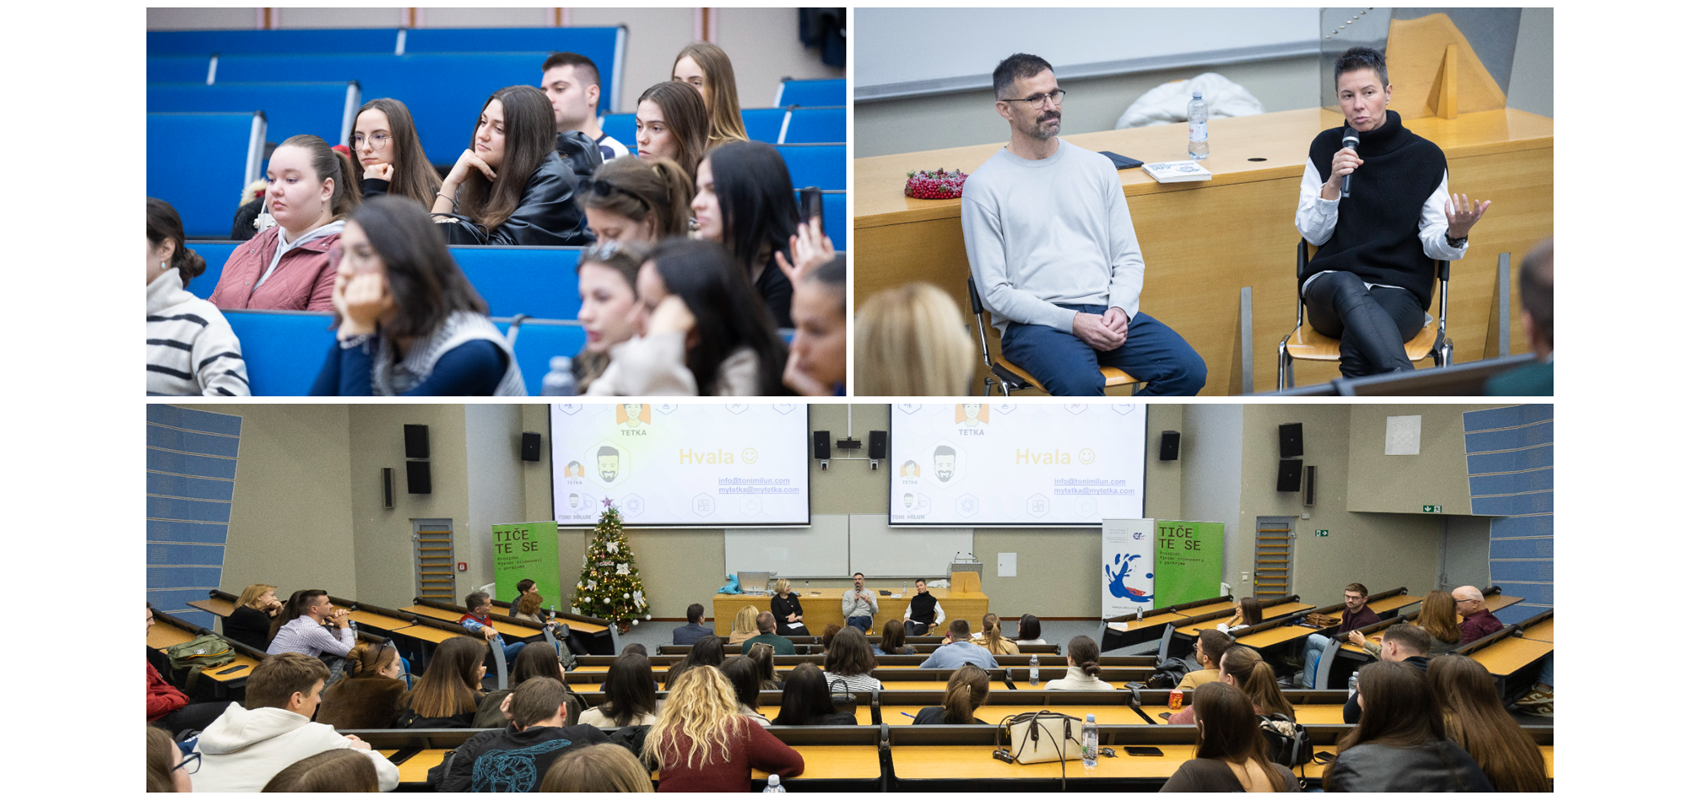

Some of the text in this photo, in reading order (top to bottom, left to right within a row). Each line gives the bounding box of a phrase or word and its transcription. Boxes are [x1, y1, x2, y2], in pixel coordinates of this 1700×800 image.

[620, 429, 647, 437] TETKA
[958, 428, 985, 436] TETKA
[679, 448, 735, 465] Hvala
[1016, 448, 1072, 465] Hvala
[718, 477, 790, 486] info@tonimilun.com
[1053, 478, 1126, 487] info@tonimilun.com
[718, 486, 800, 495] mytetka@mytetka.com
[1053, 487, 1136, 496] mytetka@mytetka.com
[494, 527, 529, 542] TIČE
[1159, 525, 1193, 539] TIČE
[495, 541, 538, 554] TE SE
[1159, 538, 1201, 551] TE SE
